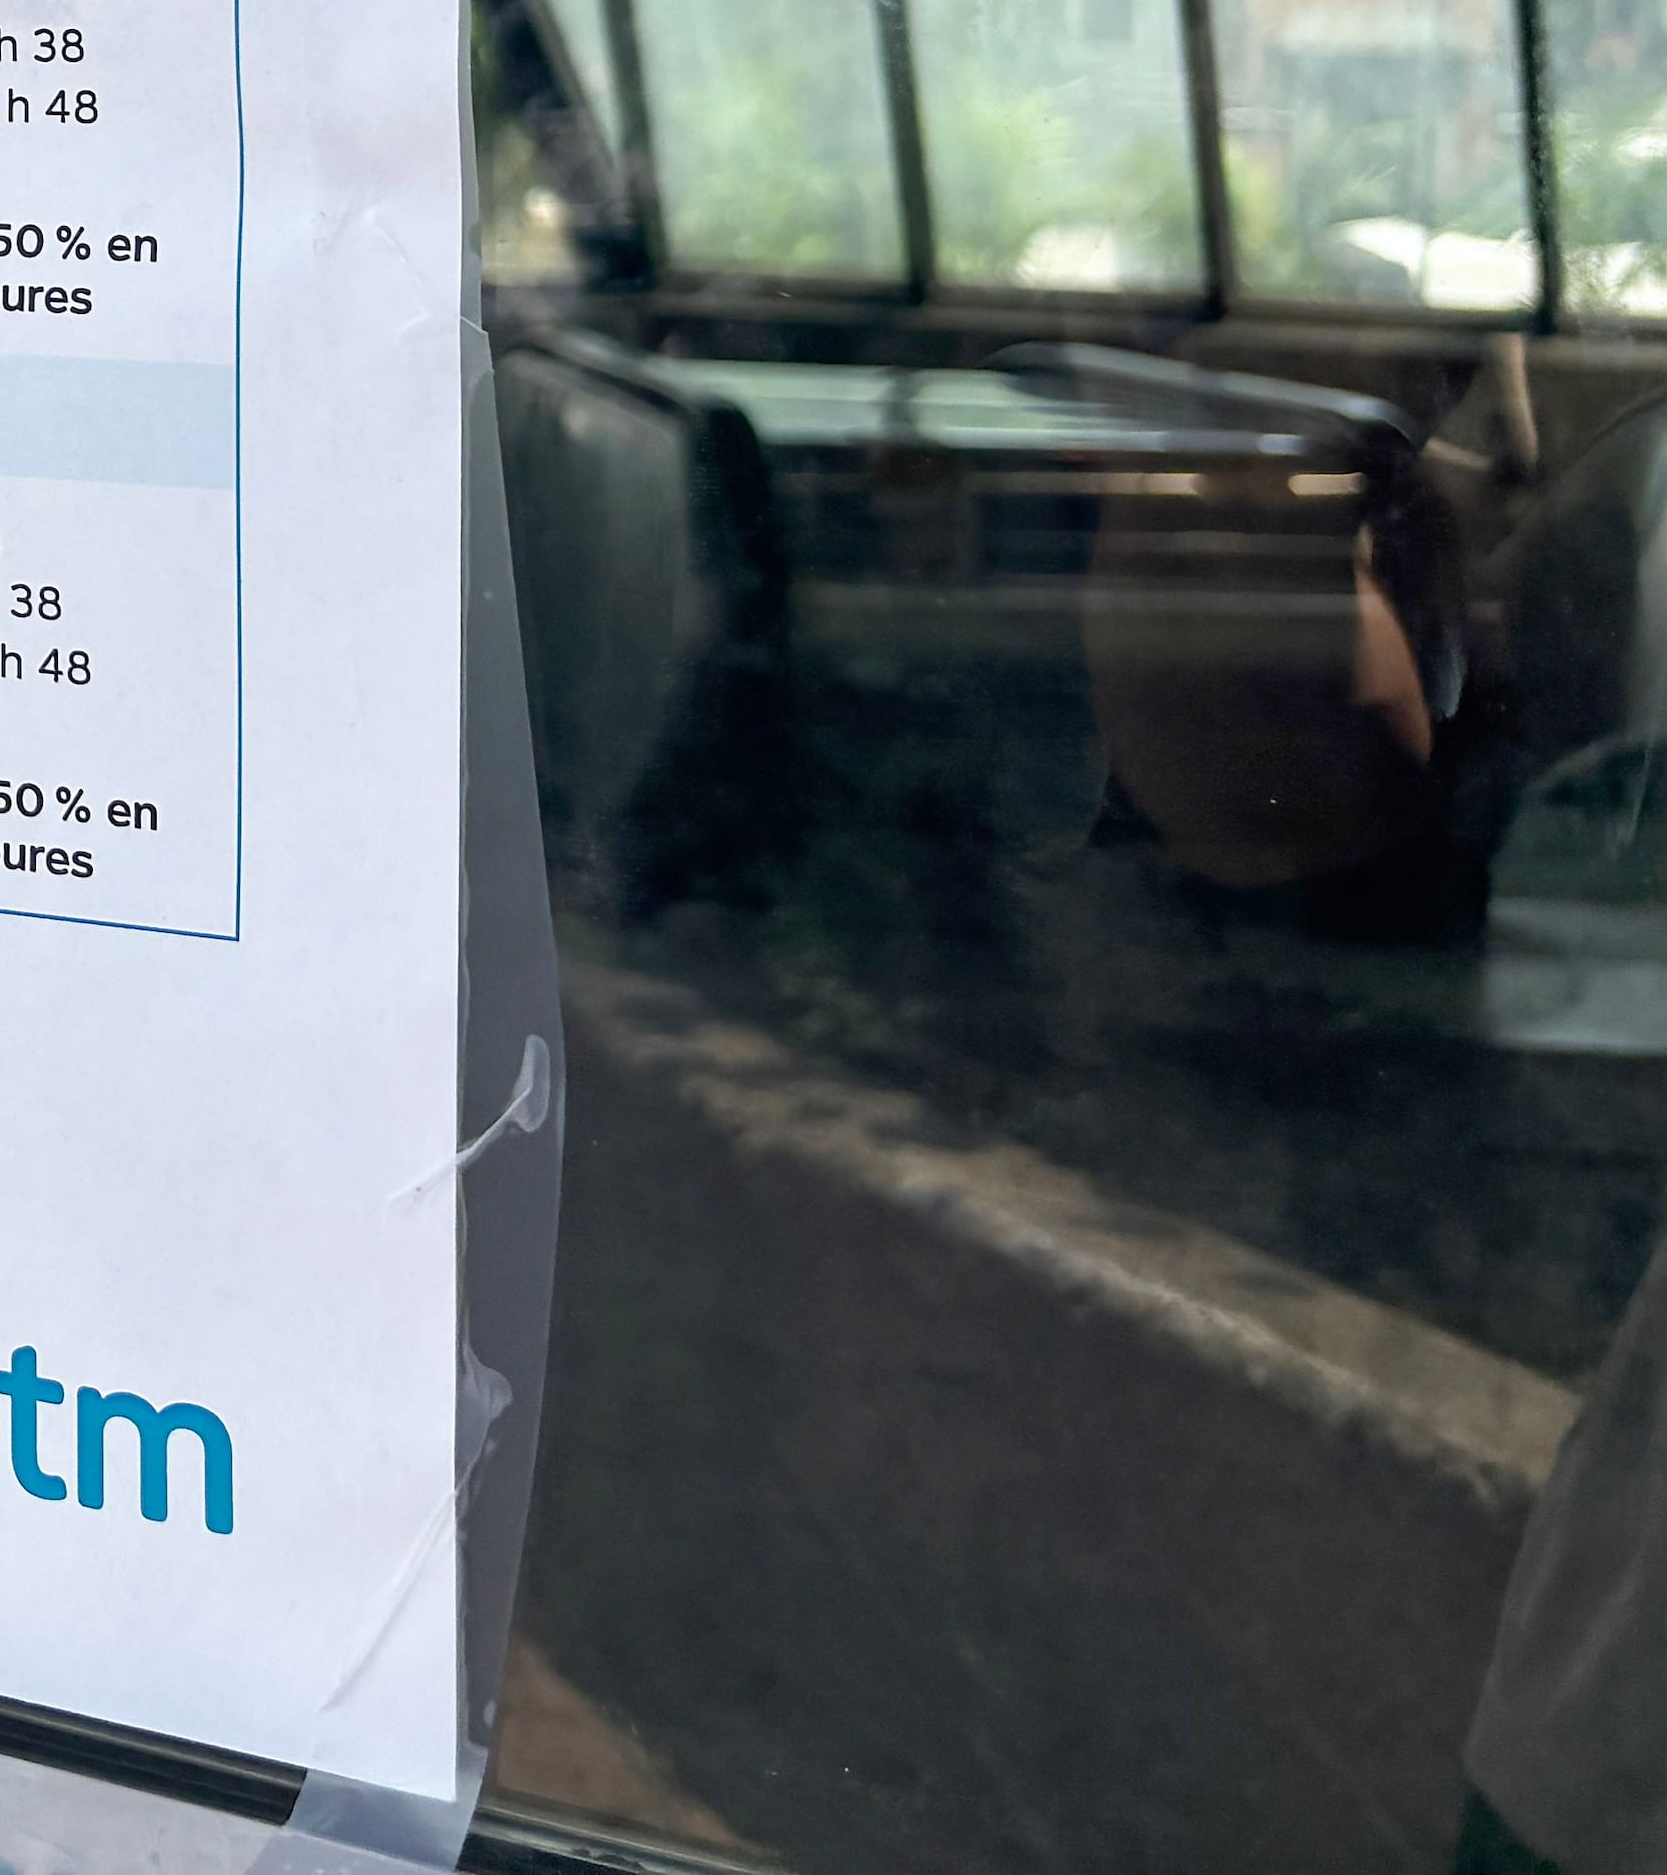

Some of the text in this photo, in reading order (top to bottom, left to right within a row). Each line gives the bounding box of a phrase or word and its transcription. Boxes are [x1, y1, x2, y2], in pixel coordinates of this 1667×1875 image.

[8, 88, 29, 123] h
[45, 90, 98, 124] 48
[108, 235, 157, 262] en
[11, 584, 61, 621] 38
[108, 800, 157, 831] en
